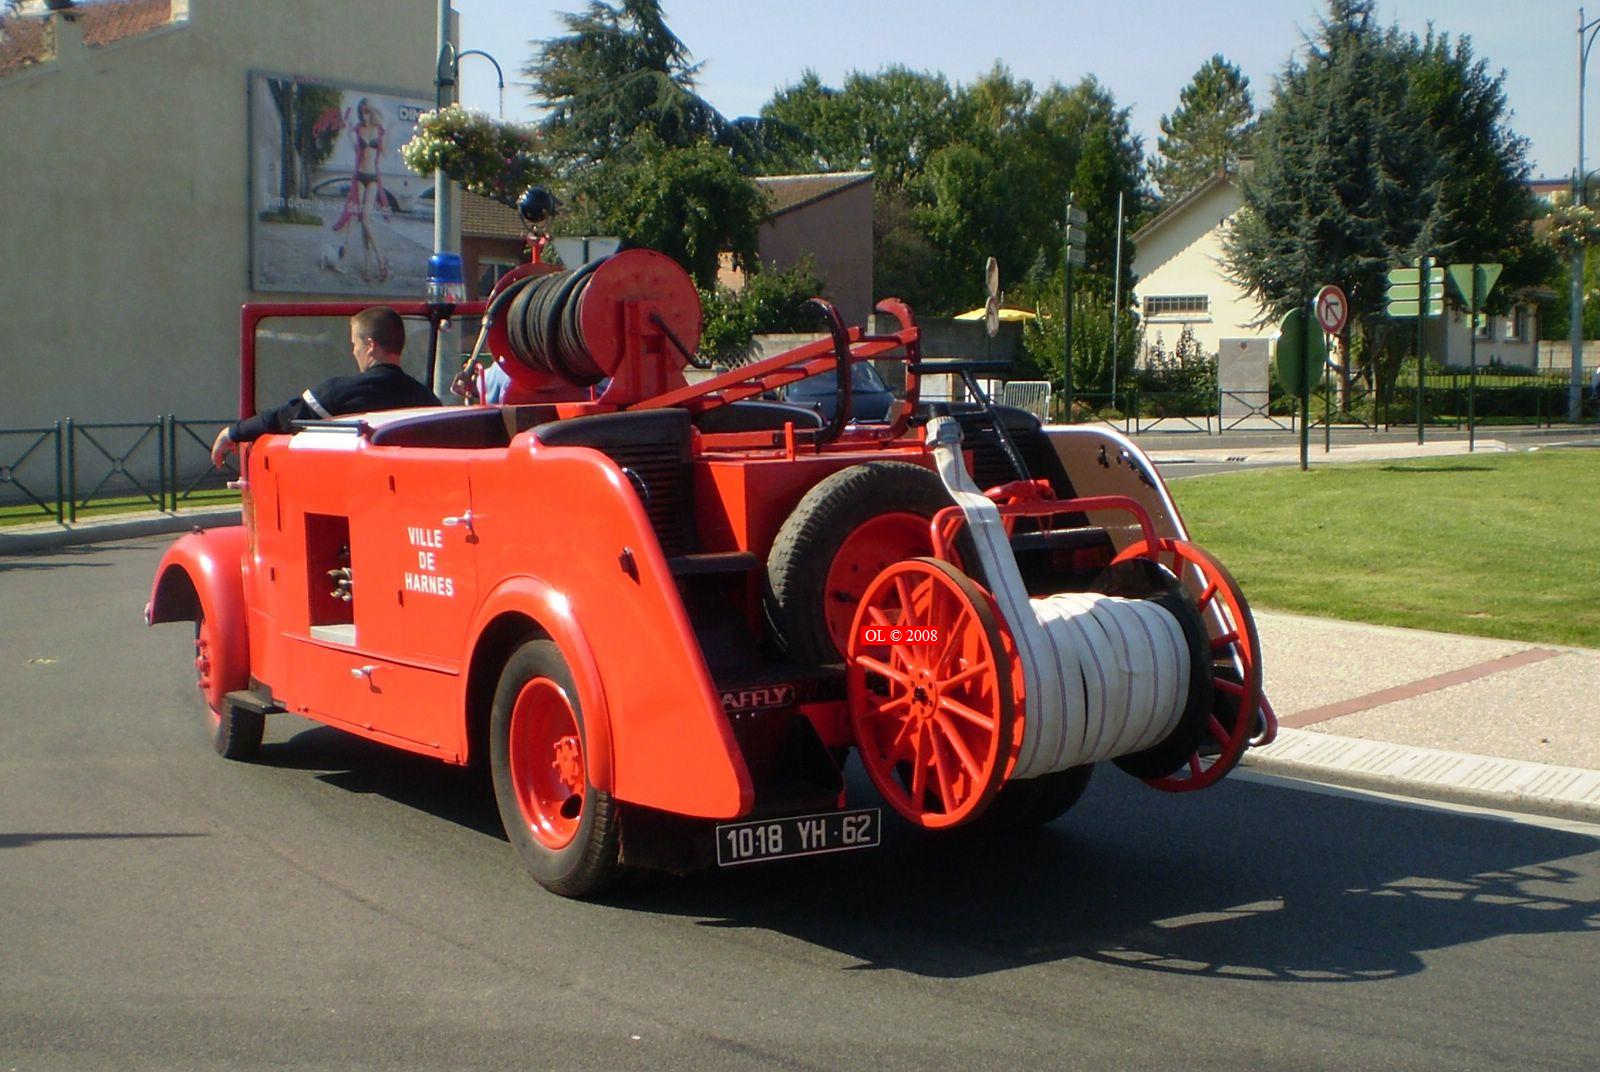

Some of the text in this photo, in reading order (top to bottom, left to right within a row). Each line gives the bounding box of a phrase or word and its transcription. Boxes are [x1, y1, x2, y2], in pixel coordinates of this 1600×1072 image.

[407, 527, 442, 547] VILLE
[418, 551, 435, 571] DE
[404, 572, 453, 596] HARNES
[721, 686, 789, 709] AFFLY
[727, 814, 871, 859] 1018 YH 62
